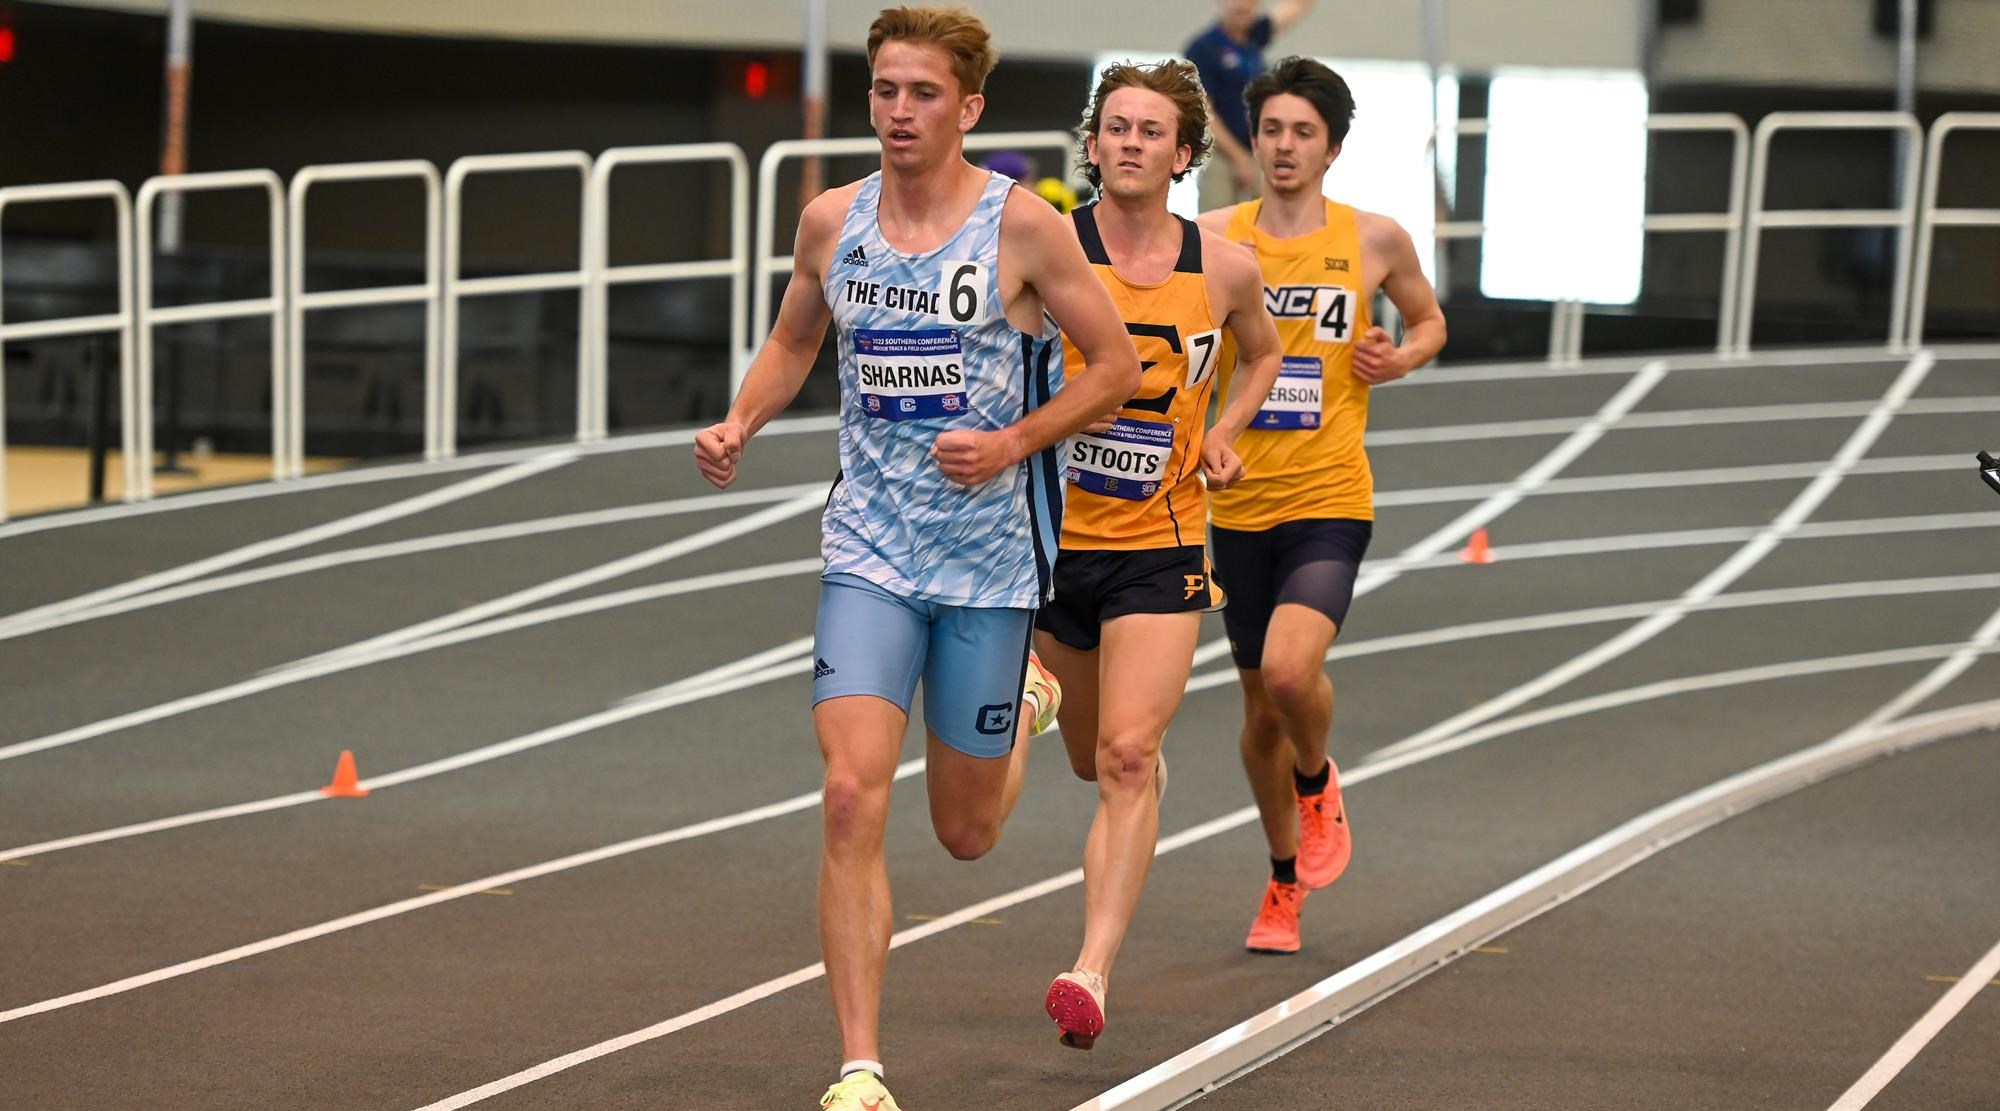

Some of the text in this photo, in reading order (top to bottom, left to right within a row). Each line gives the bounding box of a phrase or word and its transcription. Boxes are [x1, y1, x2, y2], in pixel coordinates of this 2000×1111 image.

[843, 257, 869, 268] adidas
[846, 279, 880, 306] THE
[950, 264, 978, 322] 6
[1264, 285, 1343, 318] NC
[1320, 294, 1348, 338] 4
[917, 336, 957, 345] CONFERENCE
[920, 344, 958, 352] CHAMPIONSHIPS
[1193, 334, 1215, 384] 7
[861, 363, 962, 388] SHARNAS
[1268, 387, 1319, 403] ERSON
[1135, 427, 1172, 438] CONFERENCE
[1072, 441, 1160, 474] STOOTS
[975, 702, 1011, 735] C
